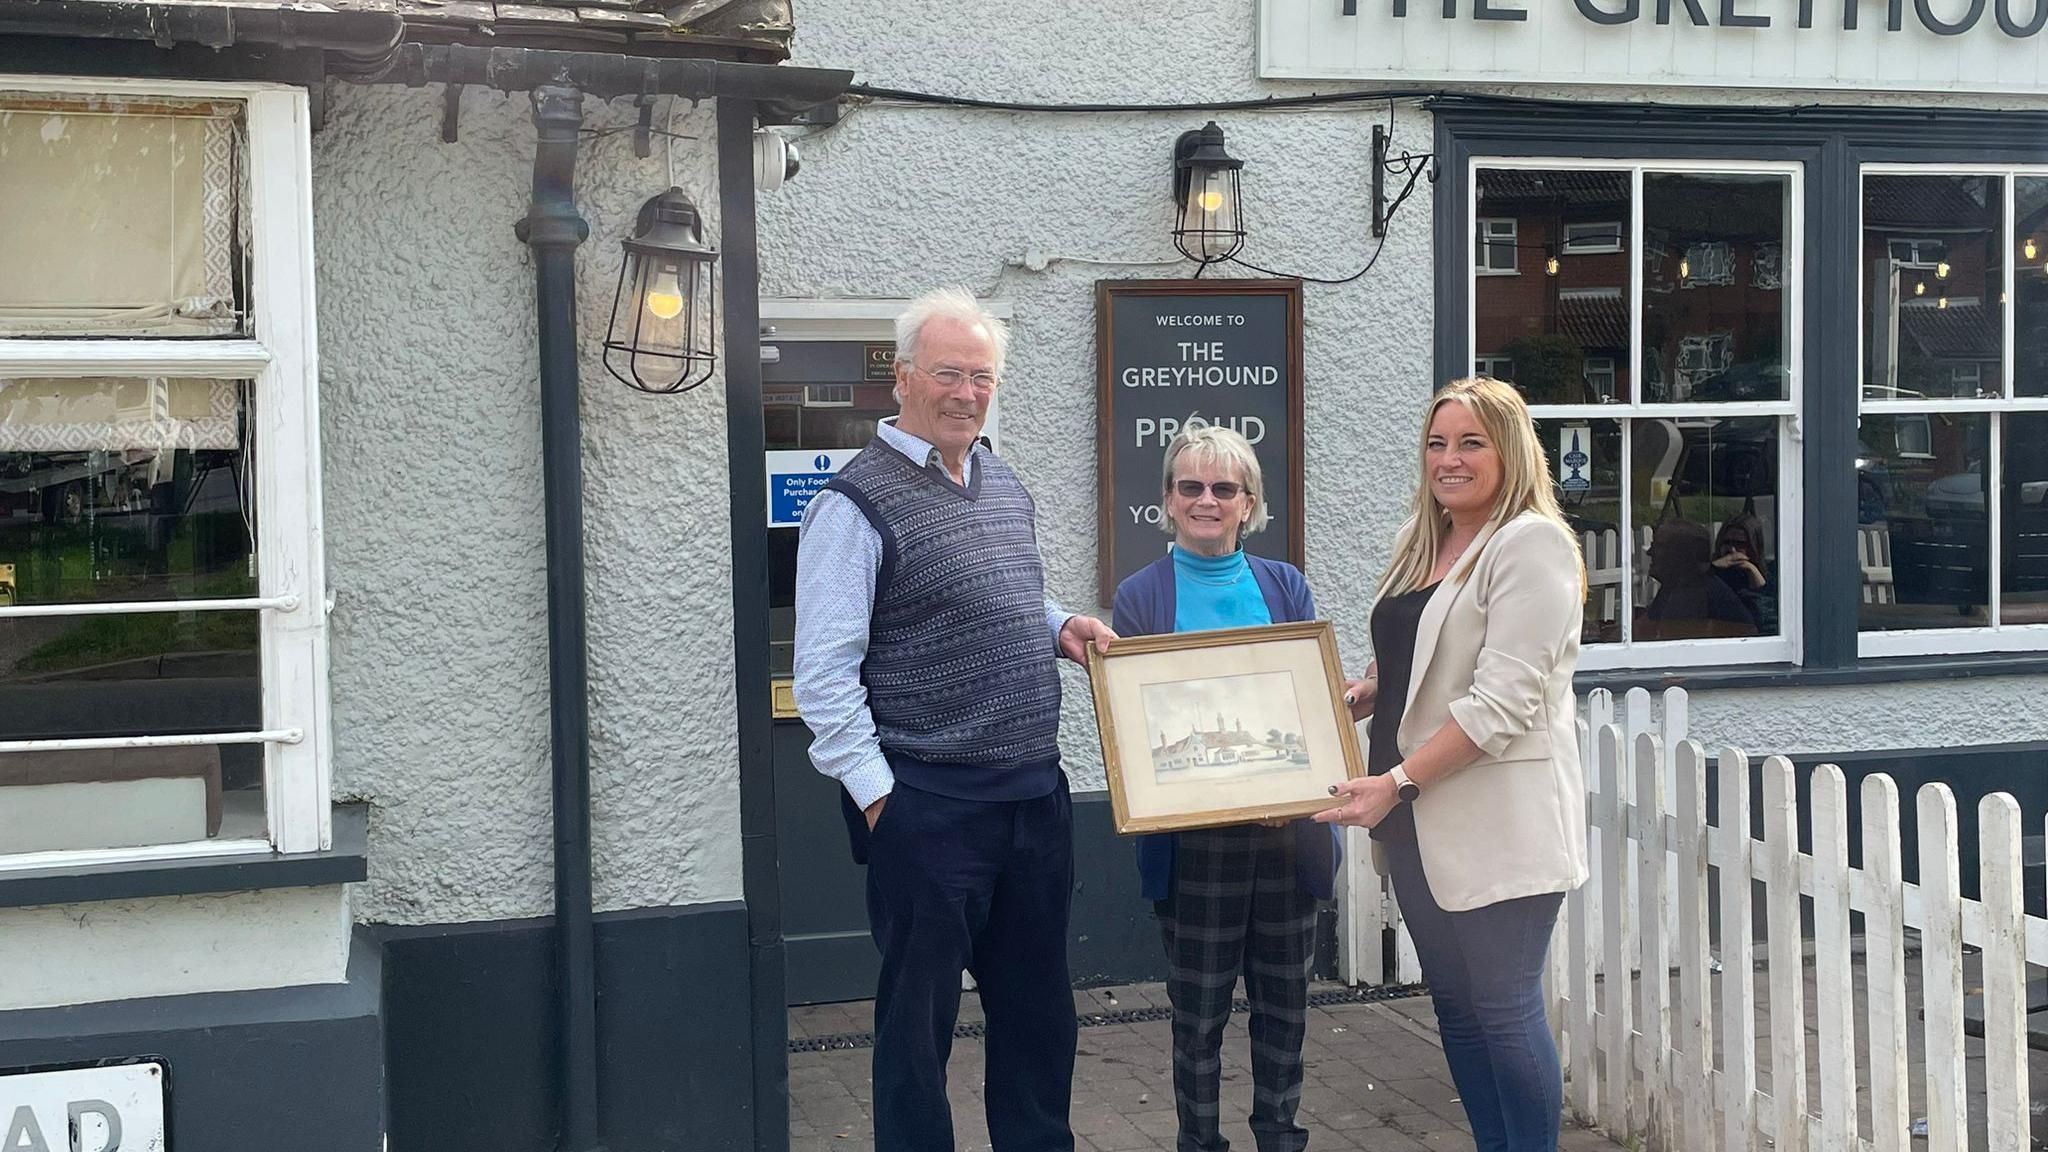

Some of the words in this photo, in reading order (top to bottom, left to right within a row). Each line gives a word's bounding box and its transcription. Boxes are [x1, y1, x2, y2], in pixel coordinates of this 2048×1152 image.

[1156, 315, 1222, 326] WELCOME
[1227, 315, 1245, 326] TO
[1177, 342, 1224, 361] THE
[1122, 366, 1279, 387] GREYHOUND
[786, 478, 806, 487] Only
[1128, 504, 1162, 524] YO
[1, 1099, 122, 1152] AD
